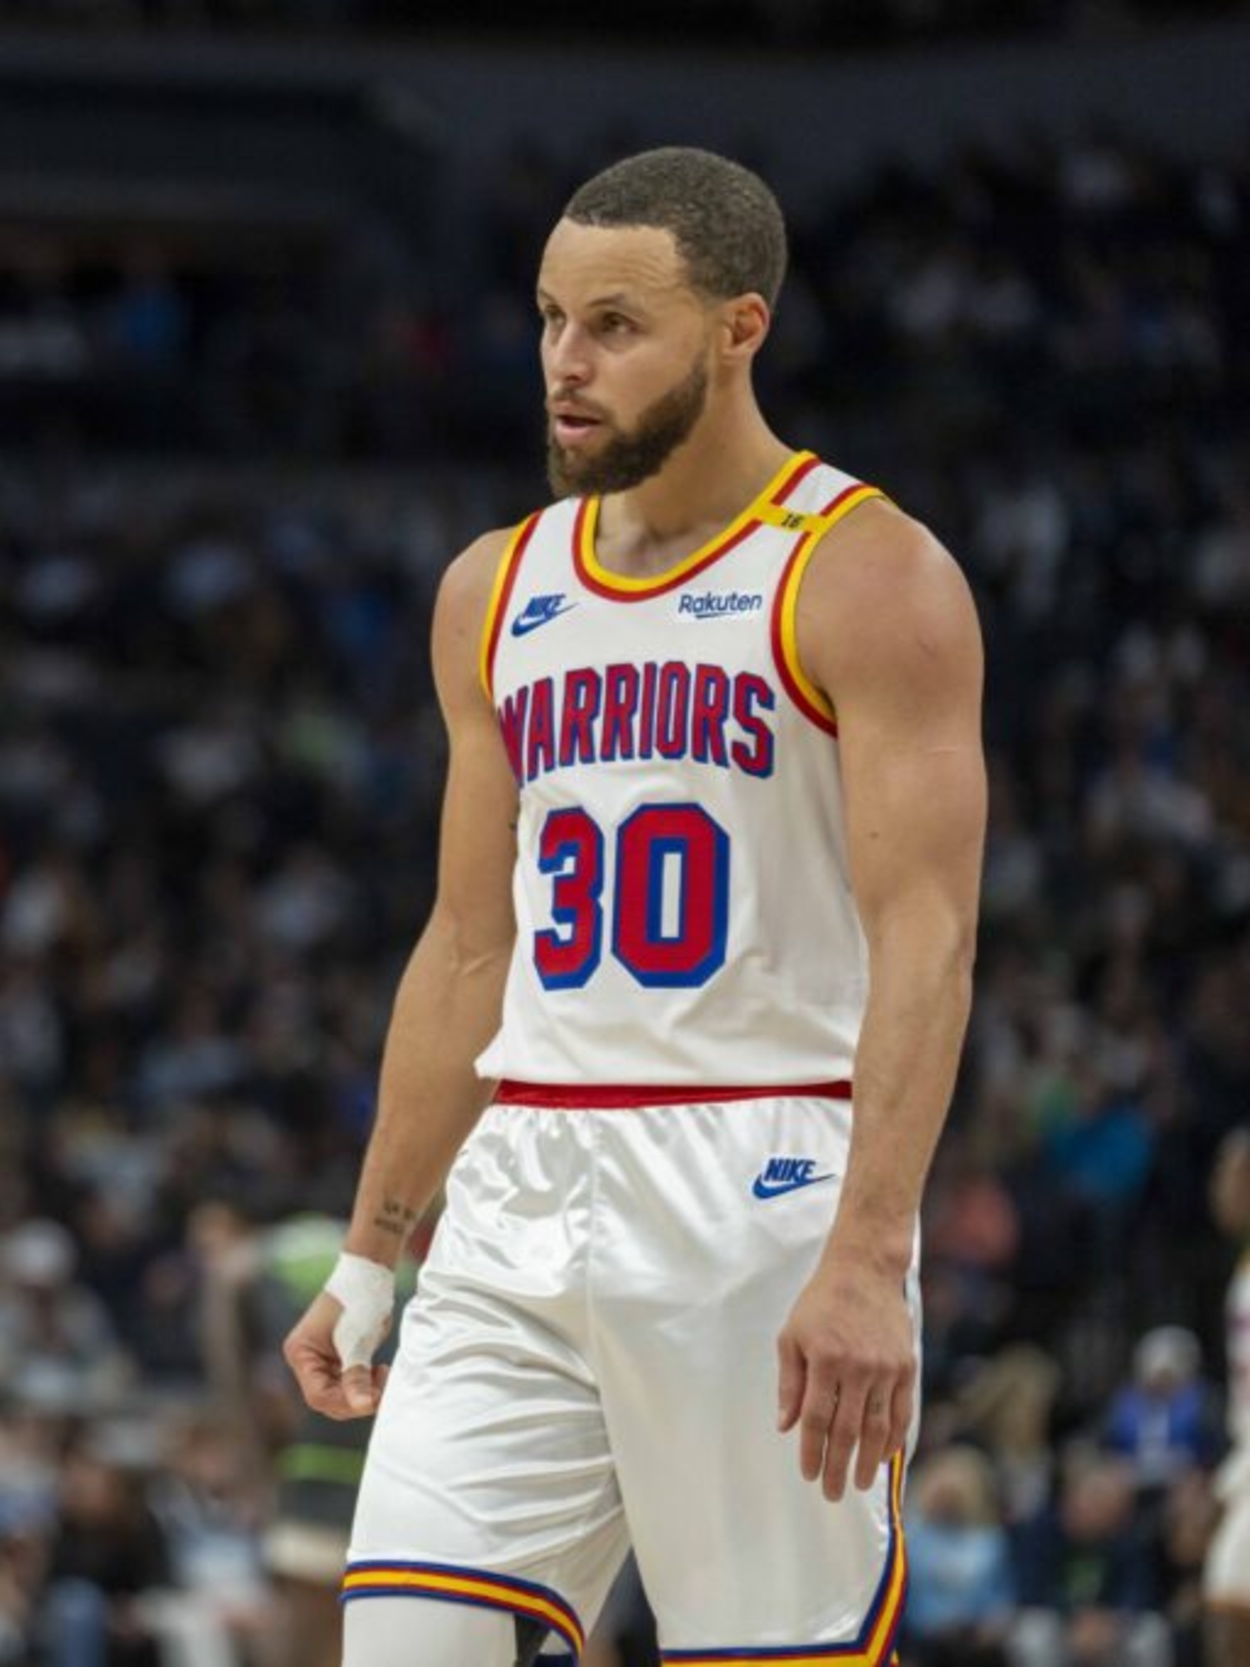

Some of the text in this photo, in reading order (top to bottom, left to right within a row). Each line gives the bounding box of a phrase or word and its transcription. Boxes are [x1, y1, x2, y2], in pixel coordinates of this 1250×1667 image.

[677, 591, 763, 614] Rakuten
[497, 661, 775, 789] WARRIORS
[533, 803, 731, 991] 30
[763, 1158, 816, 1183] NIKE
